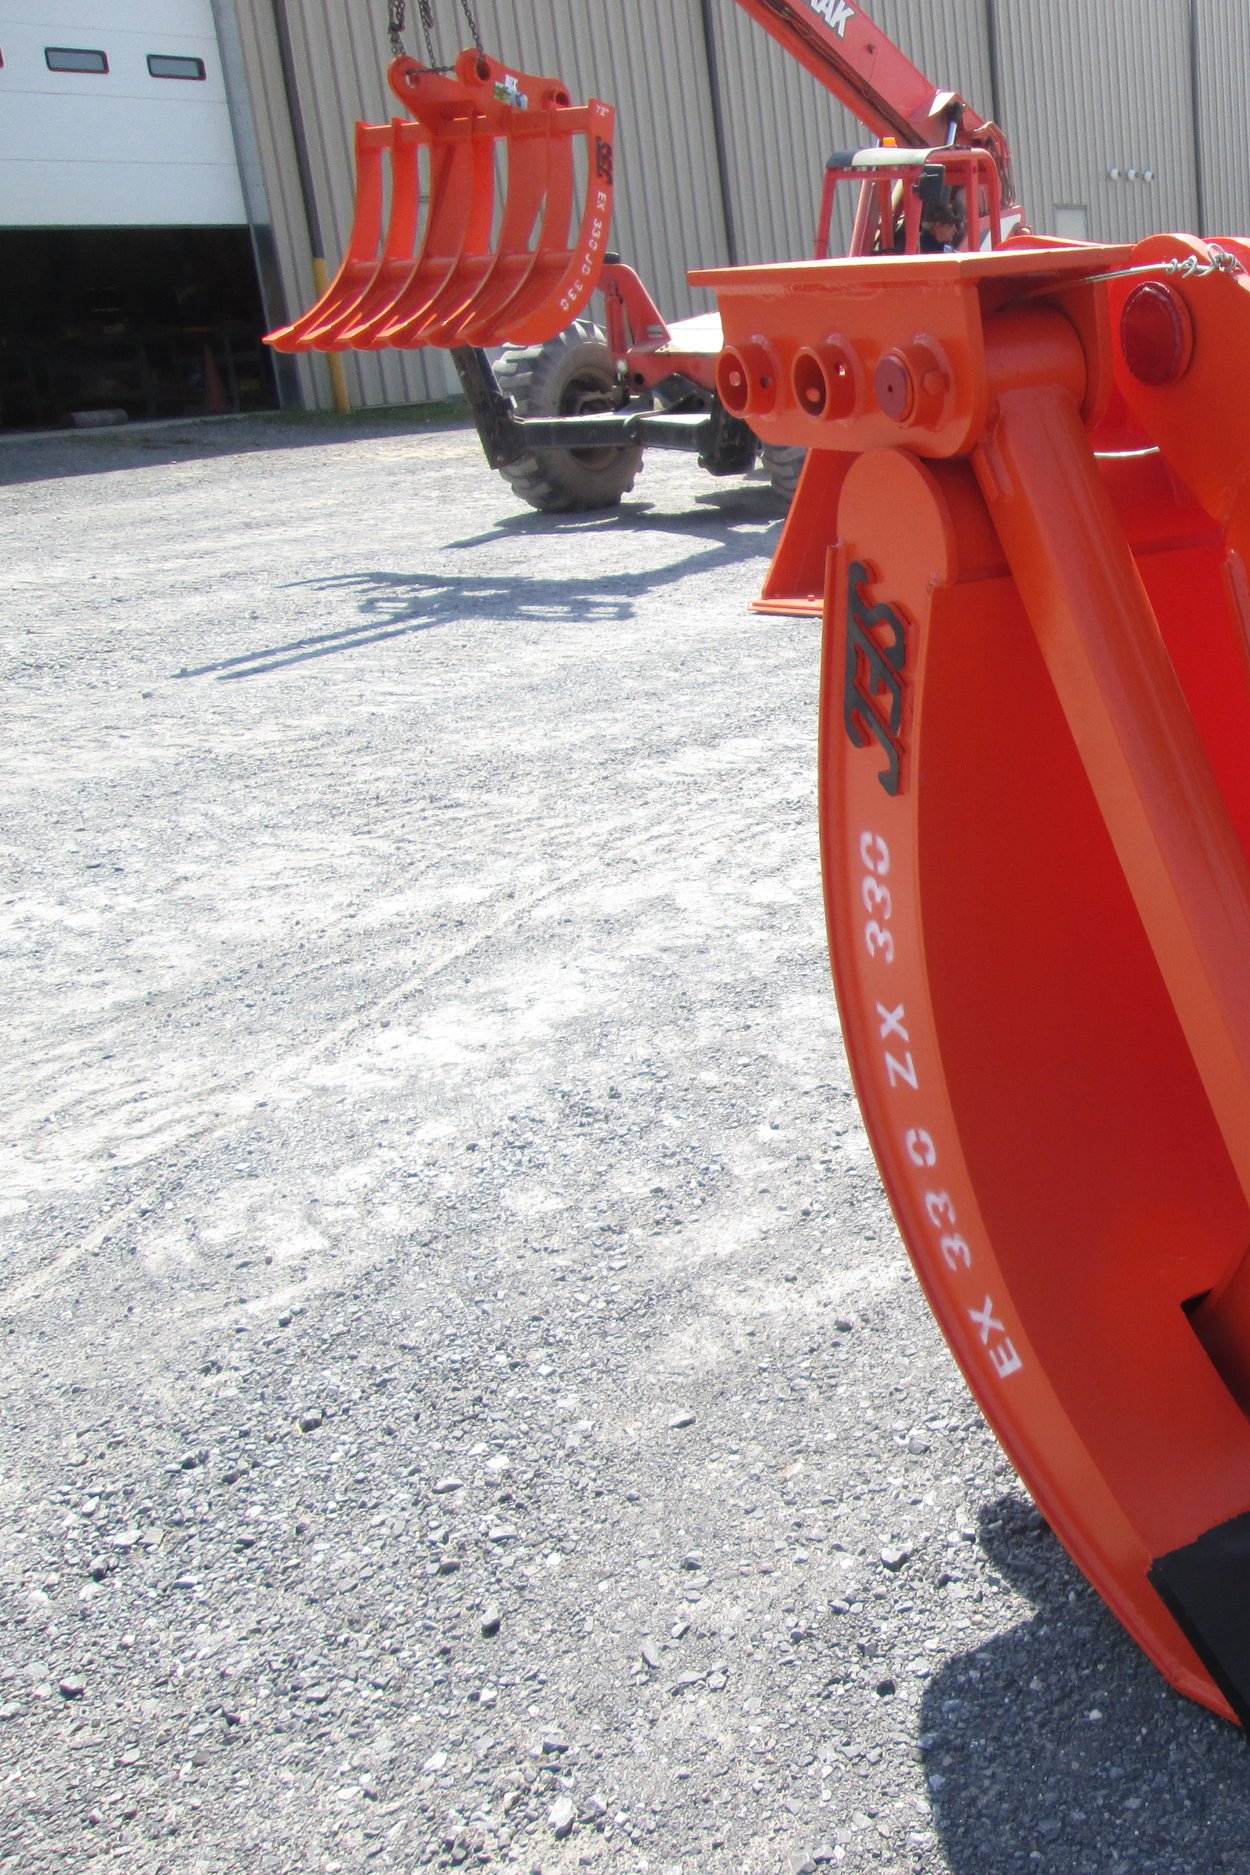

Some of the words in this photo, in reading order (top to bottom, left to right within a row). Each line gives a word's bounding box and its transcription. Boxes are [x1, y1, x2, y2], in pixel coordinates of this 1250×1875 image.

[589, 218, 602, 251] 330
[596, 191, 606, 211] EX
[844, 560, 908, 797] SEC
[859, 831, 895, 965] 330
[876, 1002, 919, 1090] ZX
[906, 1128, 972, 1272] 330
[968, 1295, 1023, 1379] EX
